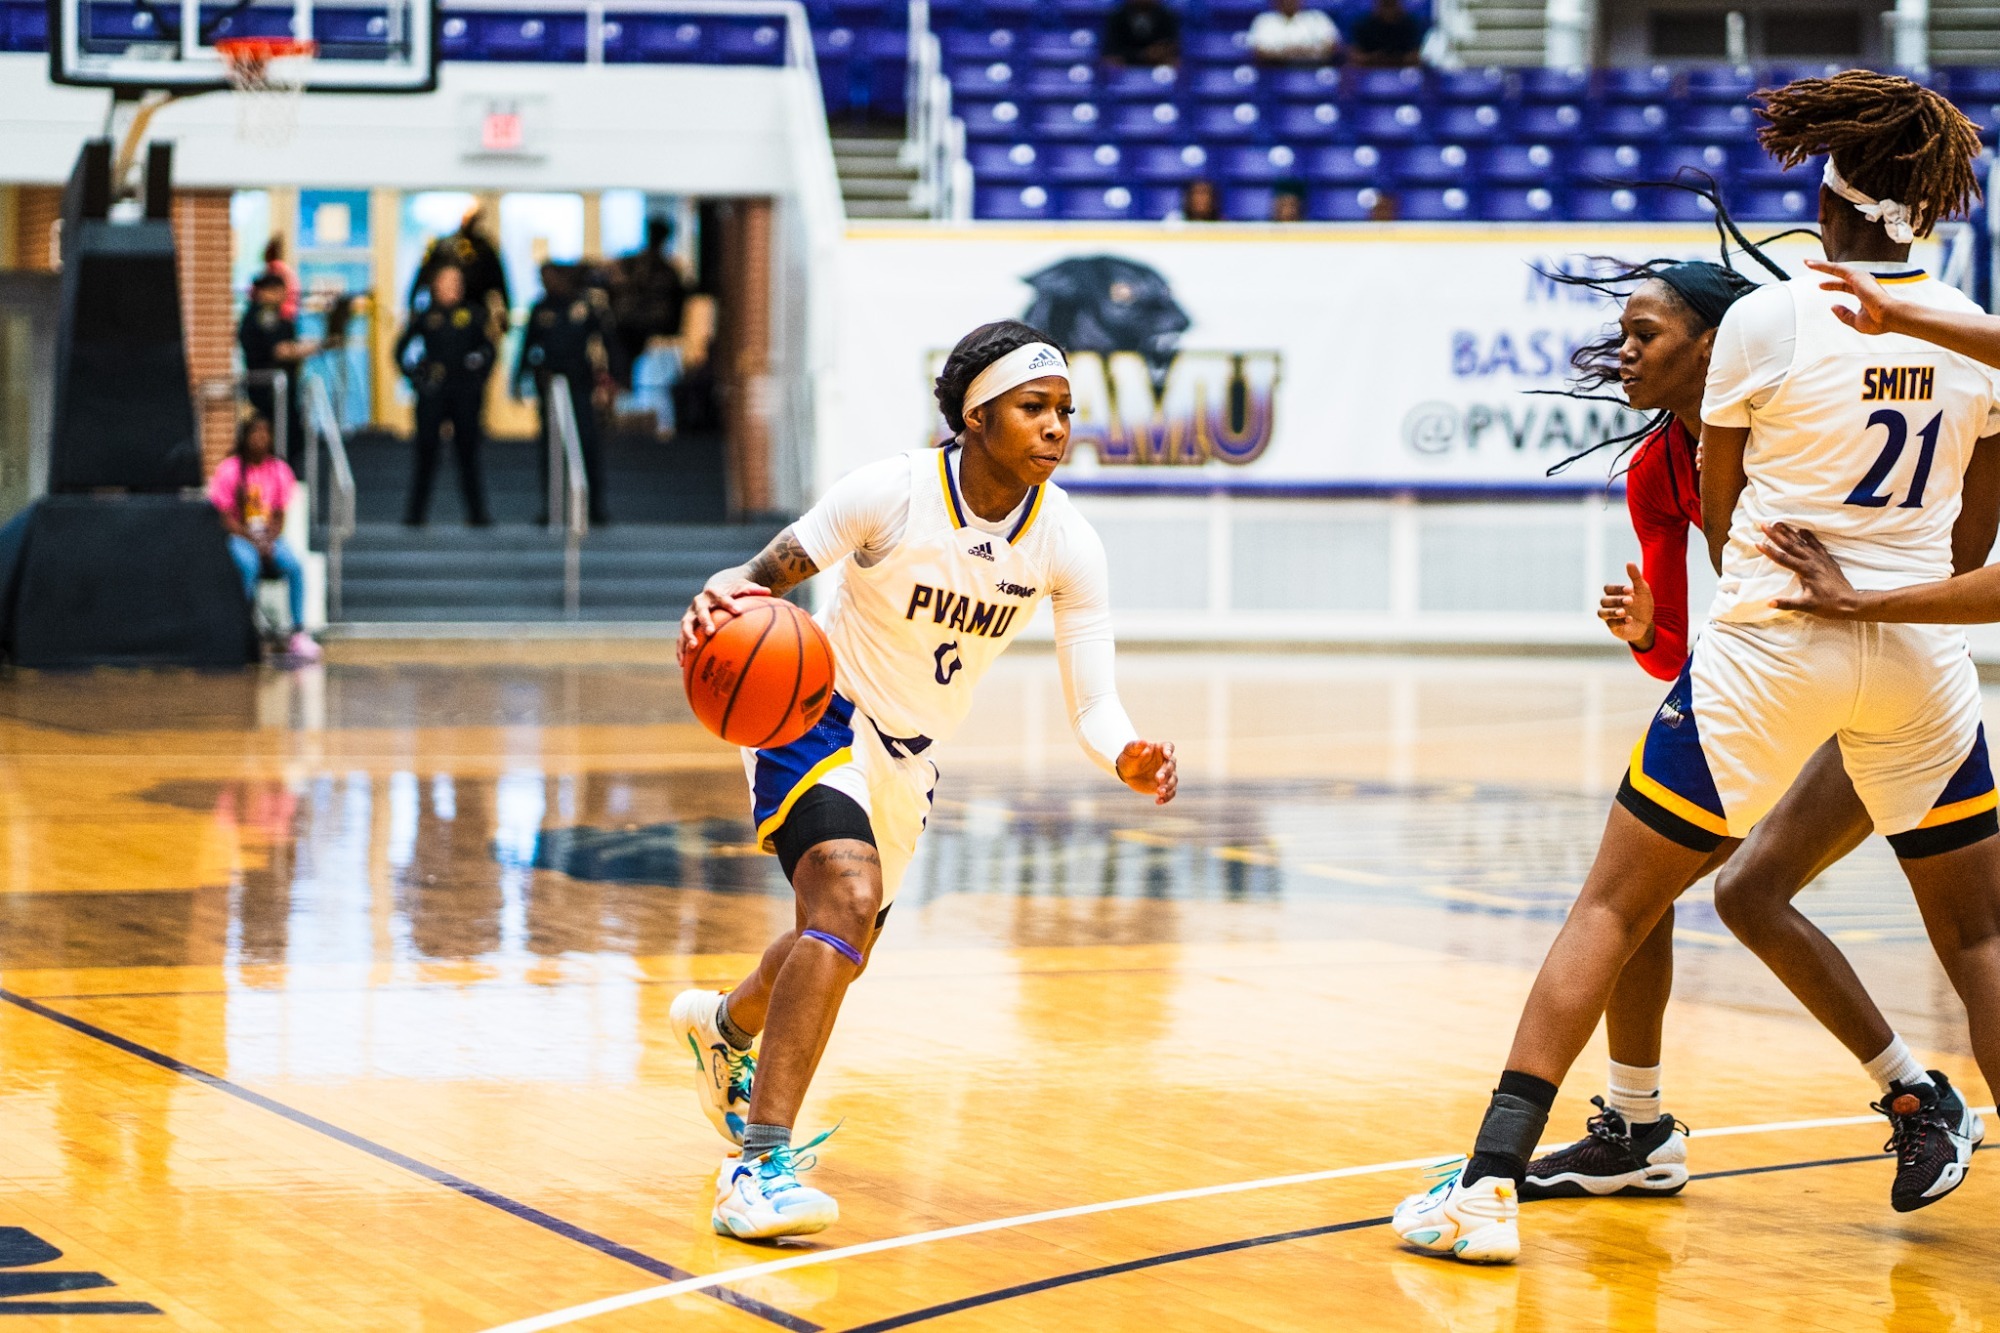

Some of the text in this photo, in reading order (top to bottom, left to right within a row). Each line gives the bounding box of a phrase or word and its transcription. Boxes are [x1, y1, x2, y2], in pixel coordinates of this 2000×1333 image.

[1450, 328, 1618, 377] BASK
[927, 349, 1283, 467] AMU
[1861, 366, 1935, 401] SMITH
[1842, 408, 1944, 509] 21
[967, 548, 995, 562] adidas
[905, 583, 1019, 639] PVAMU
